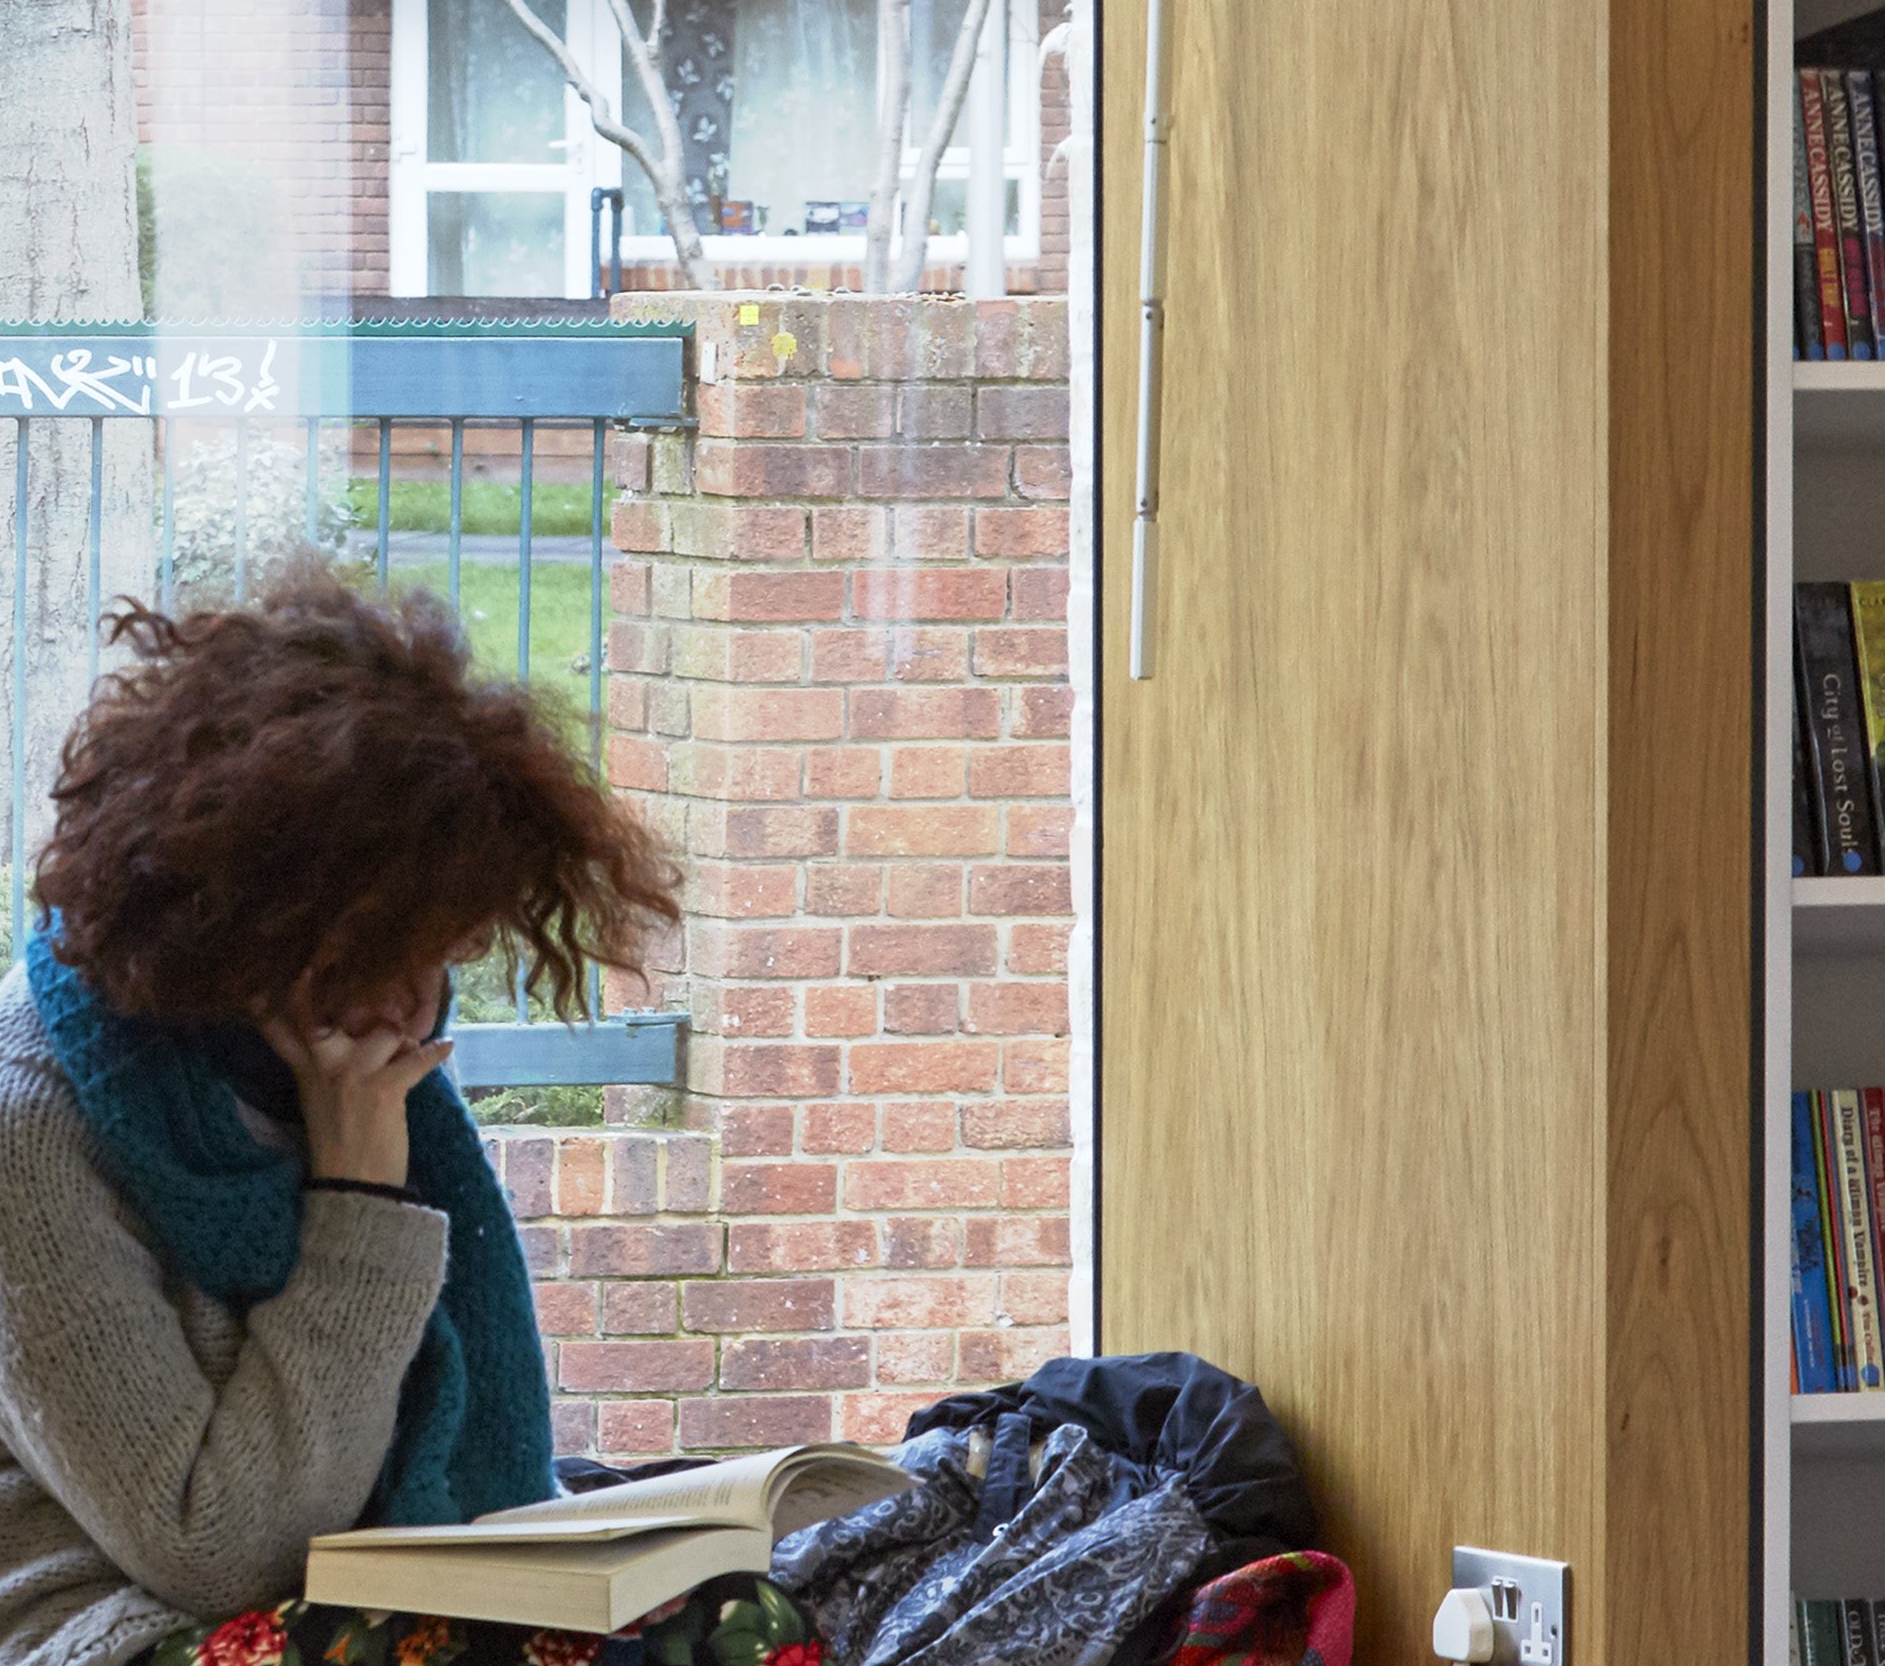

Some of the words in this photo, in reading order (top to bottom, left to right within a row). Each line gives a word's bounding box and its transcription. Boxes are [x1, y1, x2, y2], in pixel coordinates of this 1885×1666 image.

[1804, 87, 1824, 146] ANNE
[1828, 87, 1849, 145] ANNE
[1852, 90, 1873, 149] ANNE
[1809, 146, 1833, 232] CASSIDY
[1835, 146, 1858, 232] CASSIDY
[1860, 150, 1883, 236] CASSIDY
[1822, 672, 1842, 721] City
[1827, 724, 1842, 739] of
[1831, 744, 1849, 793] Lost
[1840, 1106, 1856, 1146] Diary
[1845, 1150, 1859, 1164] of
[1849, 1177, 1864, 1227] Wimpy
[1853, 1230, 1871, 1287] Vampire
[1848, 1610, 1864, 1649] OLD
